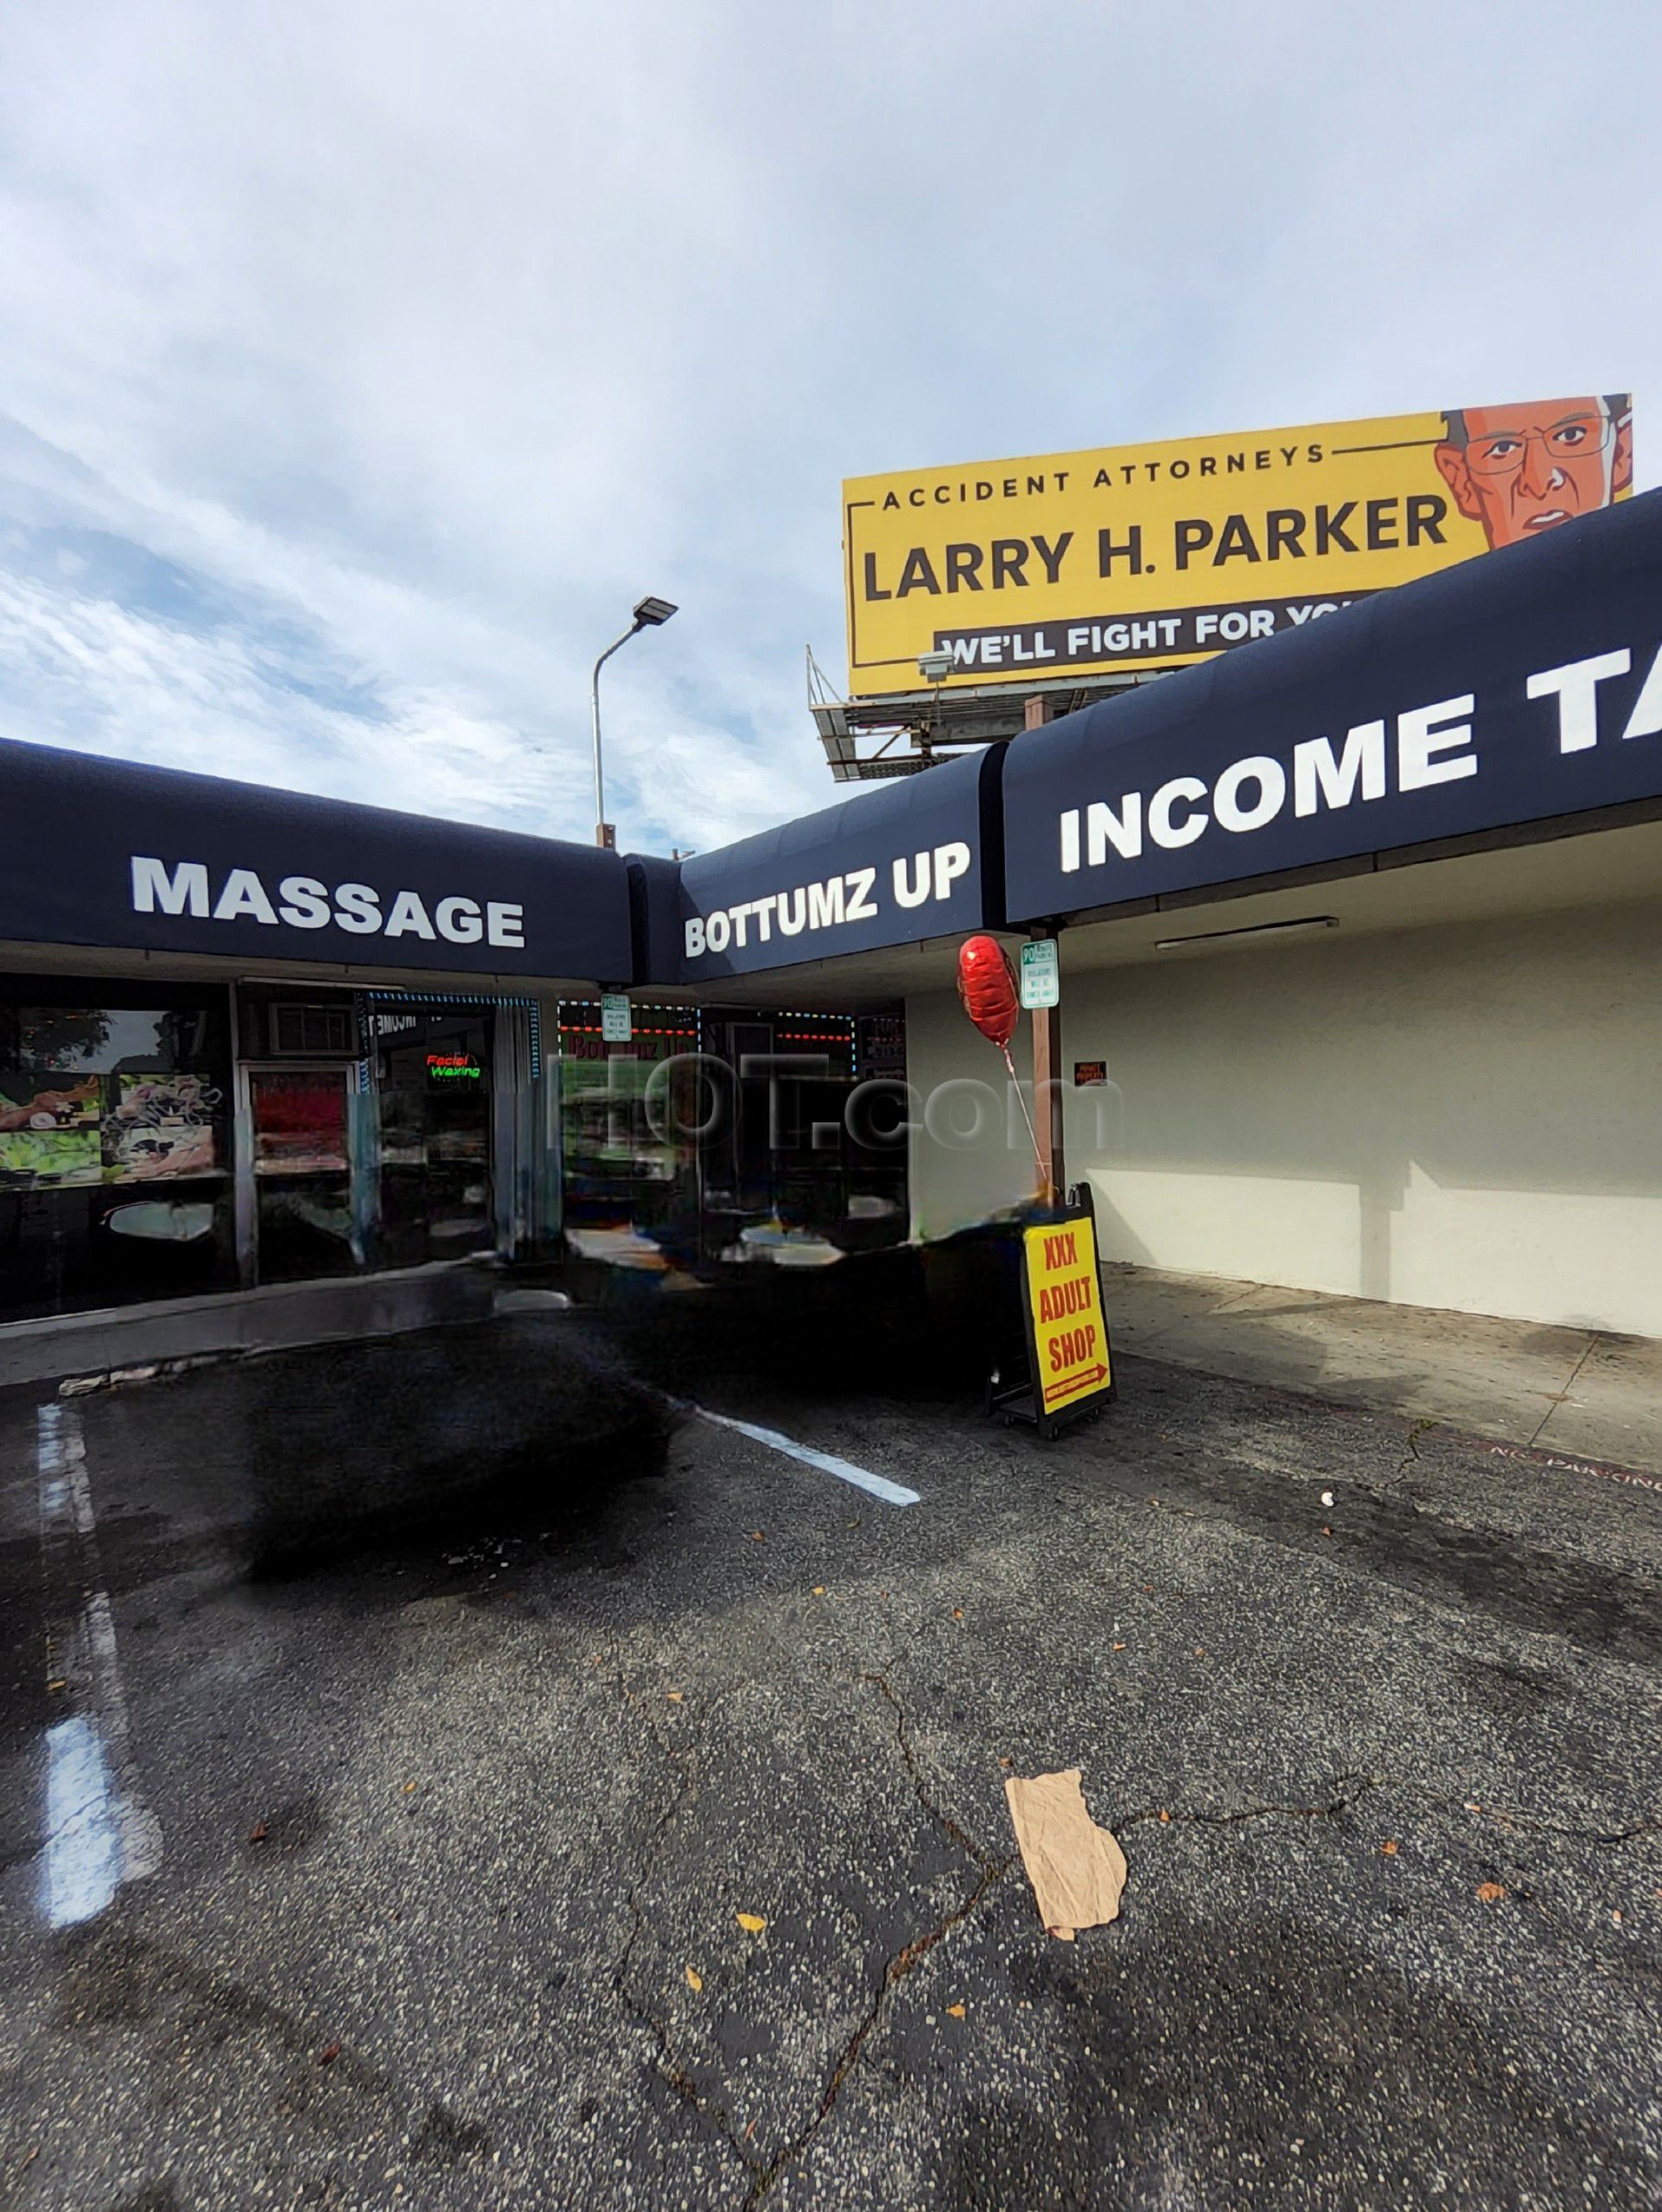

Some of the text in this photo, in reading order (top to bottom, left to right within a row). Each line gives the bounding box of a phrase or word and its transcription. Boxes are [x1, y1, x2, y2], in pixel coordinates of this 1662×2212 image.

[882, 444, 1324, 511] ACCIDENT ATTORNEYS
[864, 493, 1448, 601] LARRY H. PARKER
[940, 632, 1056, 665] WE'LL
[1068, 618, 1182, 655] FIGHT
[1195, 608, 1275, 645] FOR
[1060, 694, 1478, 873] INCOME
[131, 855, 525, 949] MASSAGE
[685, 842, 971, 958] BOTTUMZ UP
[1023, 947, 1035, 962] 90
[426, 1052, 470, 1066] Facial
[430, 1066, 481, 1079] Waxing
[1042, 1231, 1078, 1271] XXX
[1039, 1275, 1092, 1324] ADULT
[1048, 1324, 1096, 1372] SHOP
